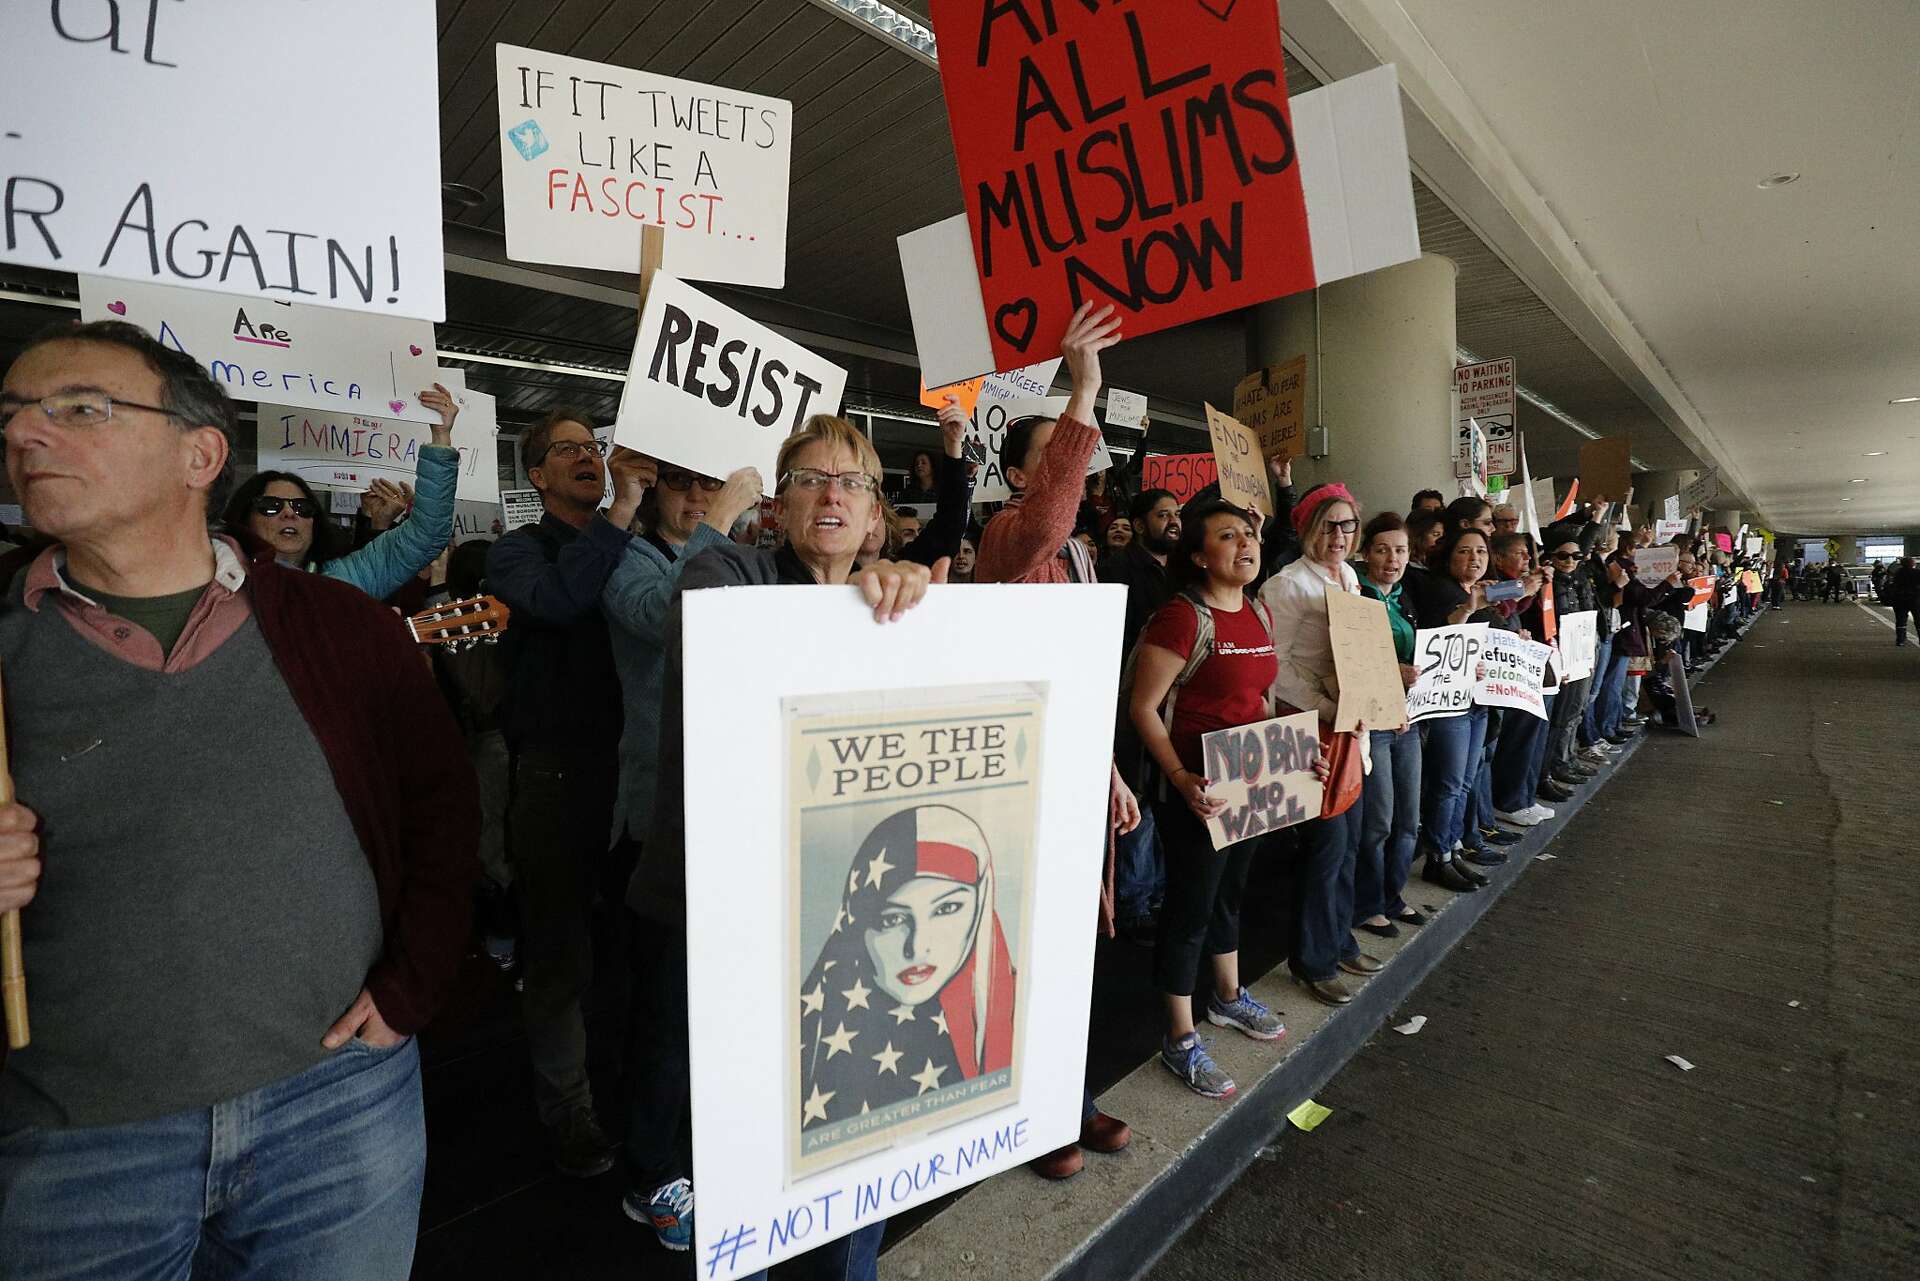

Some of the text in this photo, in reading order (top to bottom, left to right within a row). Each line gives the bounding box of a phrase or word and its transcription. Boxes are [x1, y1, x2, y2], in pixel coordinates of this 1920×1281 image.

[1014, 11, 1211, 151] ALL
[518, 67, 776, 149] IF IT TWEETS
[579, 131, 718, 189] LIKE A
[977, 69, 1296, 277] MUSLIMS
[549, 169, 756, 240] FASCIST...
[99, 182, 400, 304] AGAIN!
[1064, 201, 1245, 314] NOW
[648, 303, 823, 437] RESIST
[1280, 374, 1300, 394] FEAR
[1458, 362, 1510, 381] NO WAITING
[1472, 375, 1511, 391] PARKING
[1271, 422, 1297, 446] HERE!
[1273, 400, 1293, 419] ARE
[1213, 418, 1249, 455] END
[1488, 442, 1512, 454] FINE
[1420, 633, 1479, 677] STOP
[828, 724, 1006, 764] WE THE
[1205, 729, 1264, 787] NO
[833, 753, 1006, 796] PEOPLE
[1218, 795, 1306, 841] WALL
[808, 1074, 1009, 1148] ARE GREATER THAN FEAR
[855, 1177, 882, 1221] IN
[890, 1154, 951, 1202] OUR
[956, 1118, 1030, 1175] NAME
